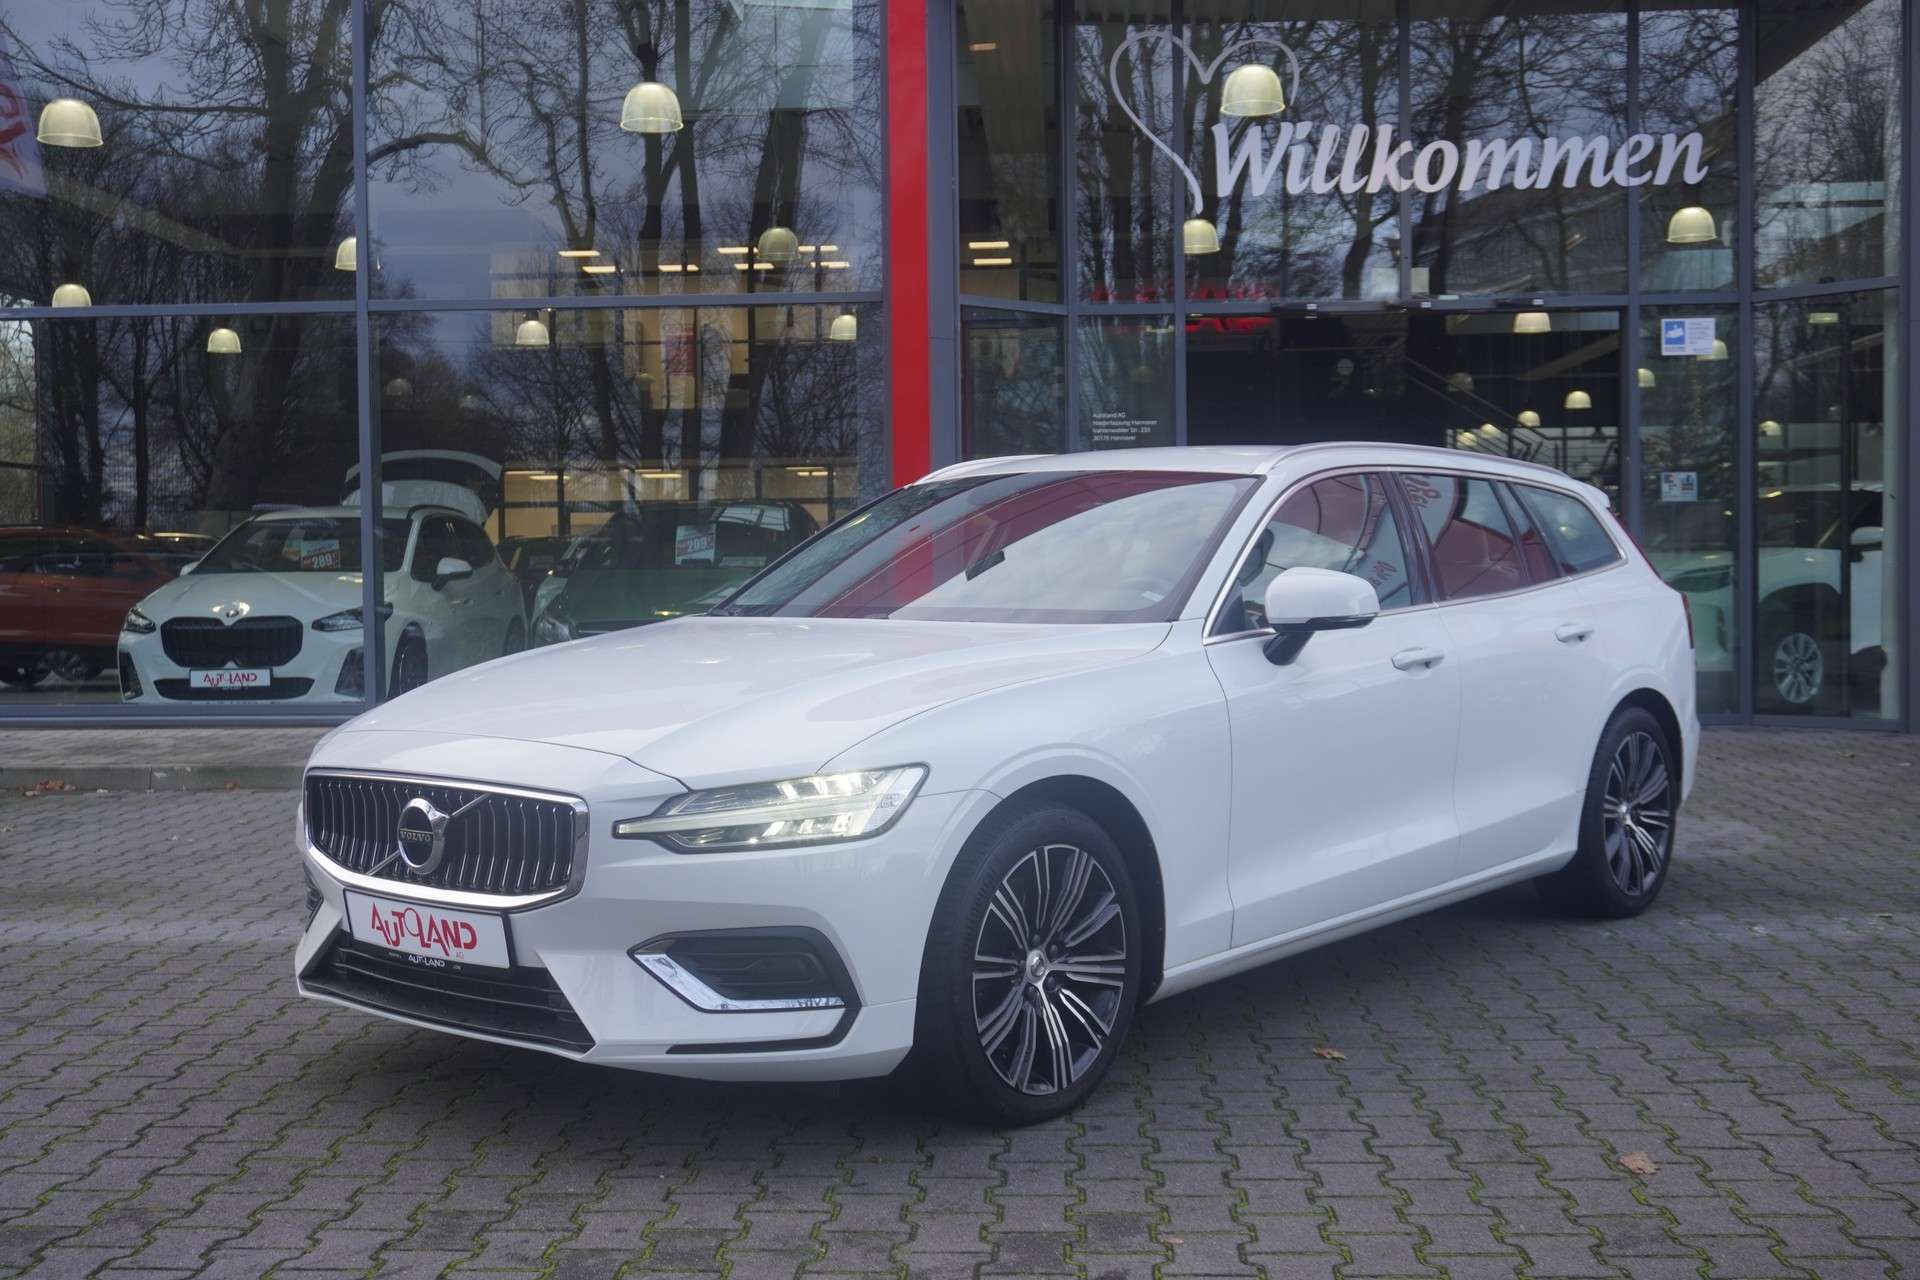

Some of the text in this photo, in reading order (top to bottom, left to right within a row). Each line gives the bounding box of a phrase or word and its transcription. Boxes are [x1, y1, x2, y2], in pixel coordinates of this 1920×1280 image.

[1210, 119, 1708, 199] Willkommen
[400, 831, 432, 843] VOLVO
[371, 902, 478, 957] AUTOLAND
